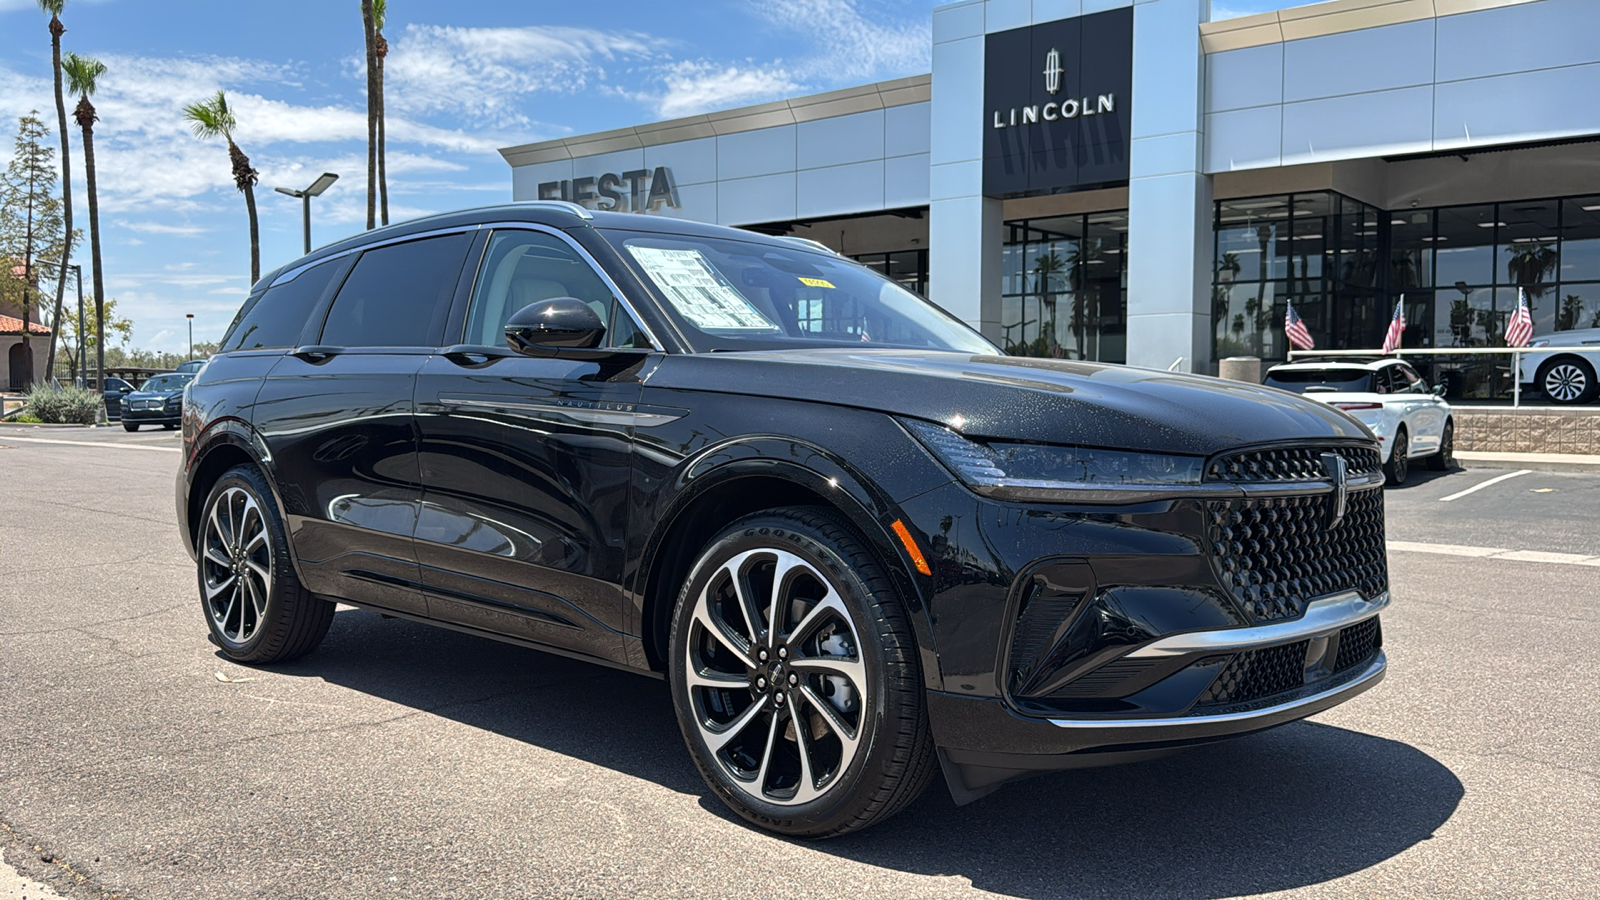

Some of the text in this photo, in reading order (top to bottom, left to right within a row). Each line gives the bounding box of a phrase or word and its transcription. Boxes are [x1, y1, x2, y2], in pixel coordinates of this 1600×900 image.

[994, 93, 1115, 128] LINCOLN
[538, 166, 681, 213] FIESTA
[556, 400, 634, 411] NAUTILUS
